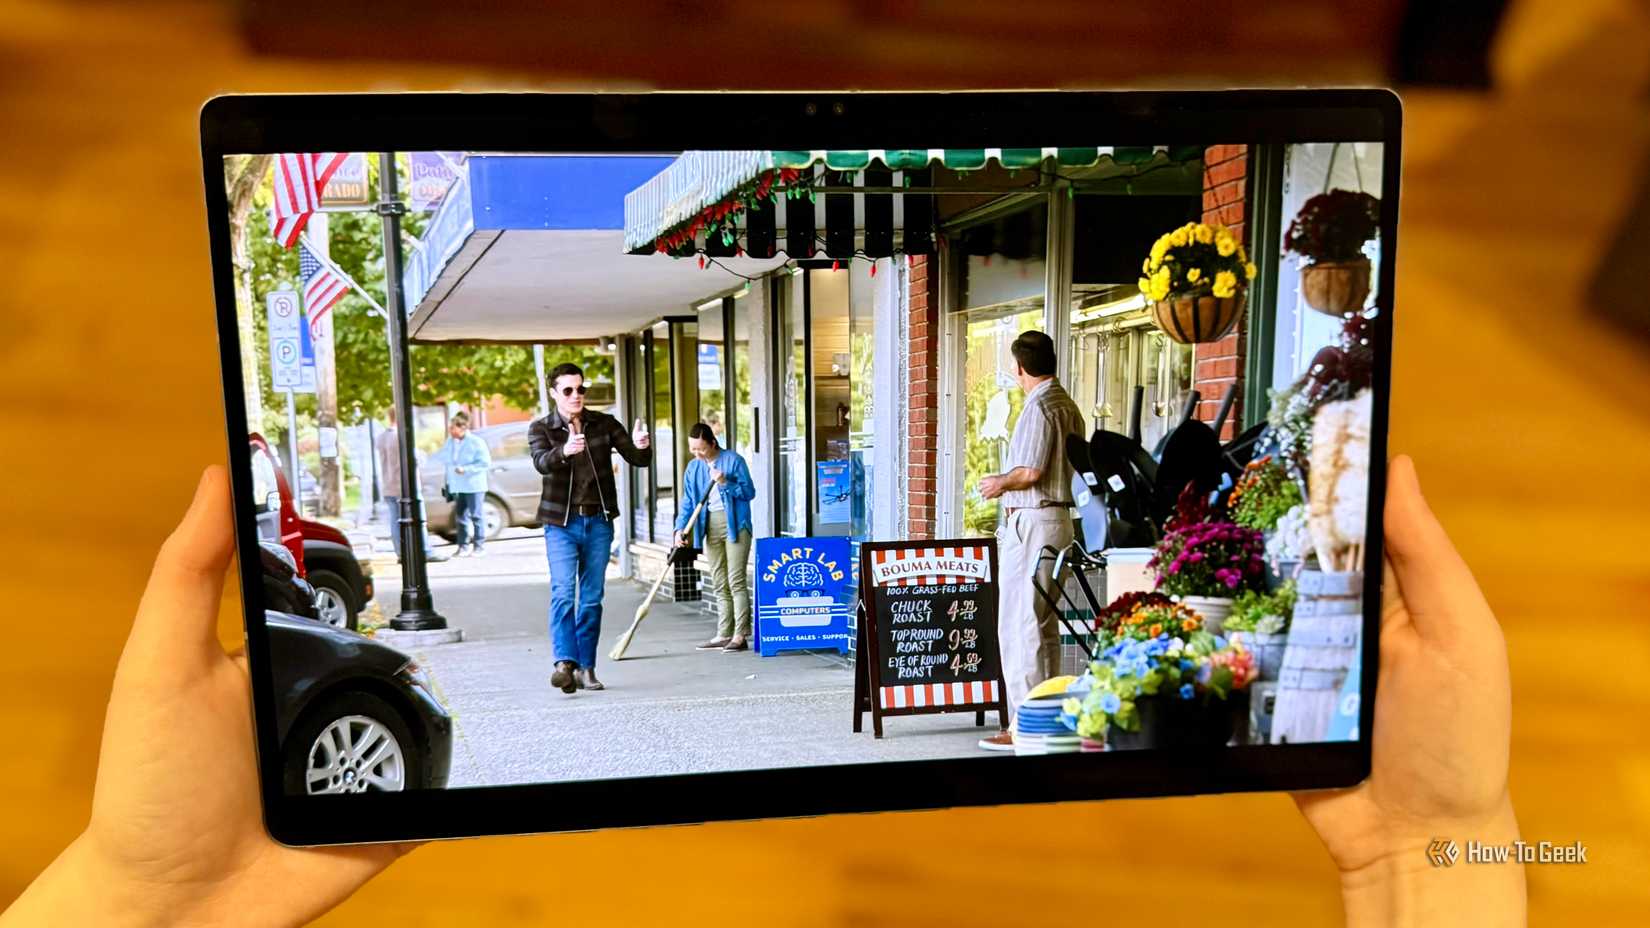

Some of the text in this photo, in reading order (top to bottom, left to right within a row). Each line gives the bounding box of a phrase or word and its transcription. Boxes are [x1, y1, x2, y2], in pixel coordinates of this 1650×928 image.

[763, 548, 844, 583] SMART LAB
[881, 561, 979, 577] BOUMA MEATS
[886, 584, 980, 596] 100% GRASS-FED BEEF
[780, 607, 831, 615] COMPUTERS
[890, 600, 933, 613] CHUCK
[892, 611, 933, 624] ROAST
[762, 634, 790, 642] SERVICE
[796, 633, 817, 641] SALES
[896, 640, 934, 653] ROAST
[888, 653, 949, 668] EYE OF ROUND
[898, 665, 934, 679] ROAST
